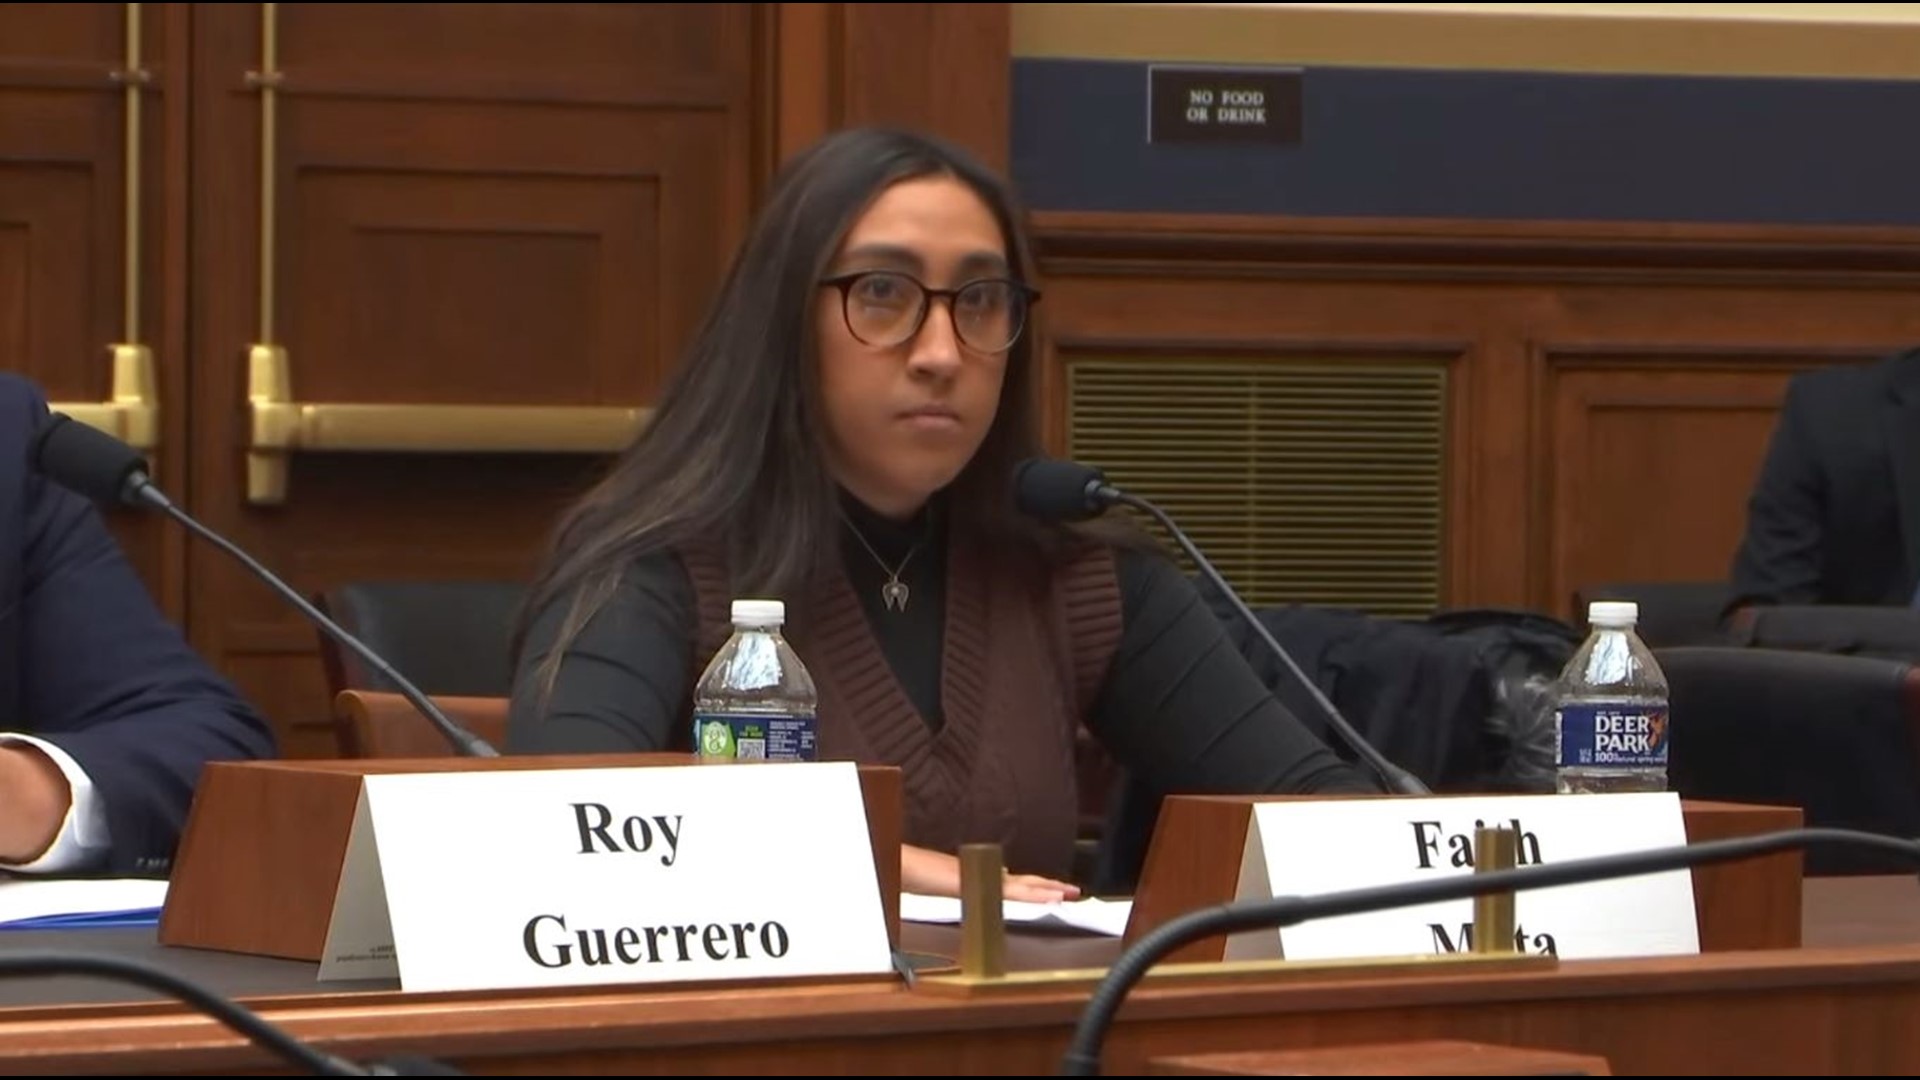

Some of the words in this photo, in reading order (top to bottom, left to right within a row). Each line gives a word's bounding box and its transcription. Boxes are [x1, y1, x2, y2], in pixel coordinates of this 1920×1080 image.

[1189, 90, 1213, 105] NO
[1221, 91, 1265, 105] FOOD
[1186, 107, 1209, 122] OR
[1217, 108, 1267, 124] DRINK
[1594, 716, 1651, 733] DEER
[1594, 734, 1652, 754] PARK
[569, 802, 683, 867] Roy
[1408, 819, 1544, 869] Fah
[523, 914, 790, 968] Guerrero
[1427, 923, 1560, 960] Mta
